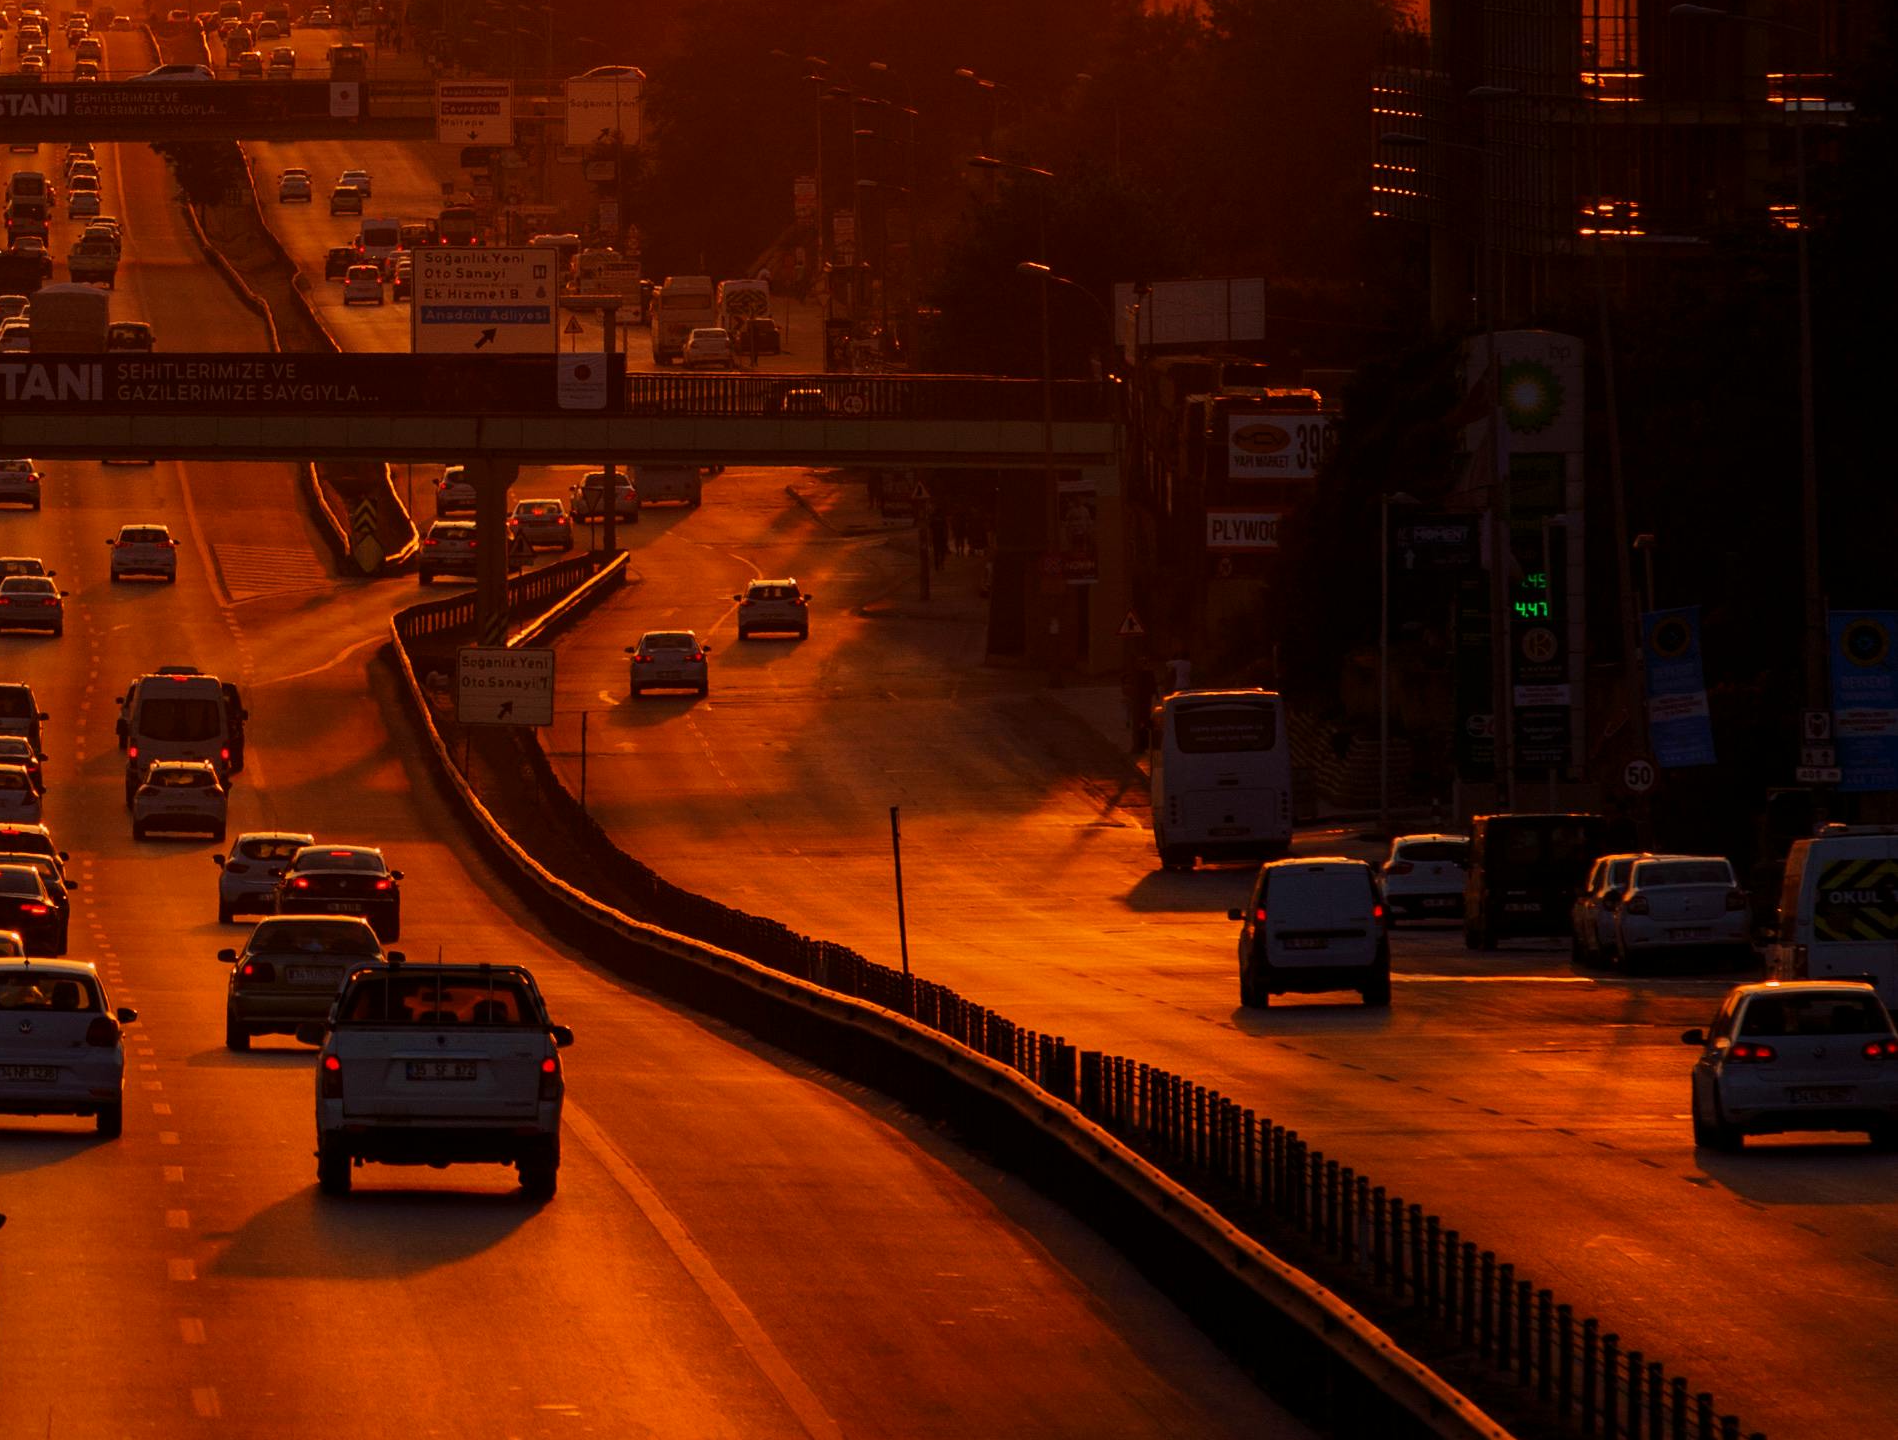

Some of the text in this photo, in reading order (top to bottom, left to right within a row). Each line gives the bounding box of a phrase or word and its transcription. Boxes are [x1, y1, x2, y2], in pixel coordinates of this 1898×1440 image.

[424, 252, 525, 266] Soğanlık Yeni
[424, 268, 506, 281] Oto Sanayi
[424, 288, 443, 300] Ek
[447, 288, 504, 300] Hizmet
[425, 307, 548, 322] Anadolu Adliyesi
[272, 363, 297, 380] VE
[1514, 601, 1549, 618] 4.47
[462, 655, 549, 670] Soğanlık Yeni
[462, 677, 486, 688] Oto
[488, 677, 535, 690] Sanayi
[1628, 766, 1651, 786] 50
[1829, 890, 1884, 905] OKUL
